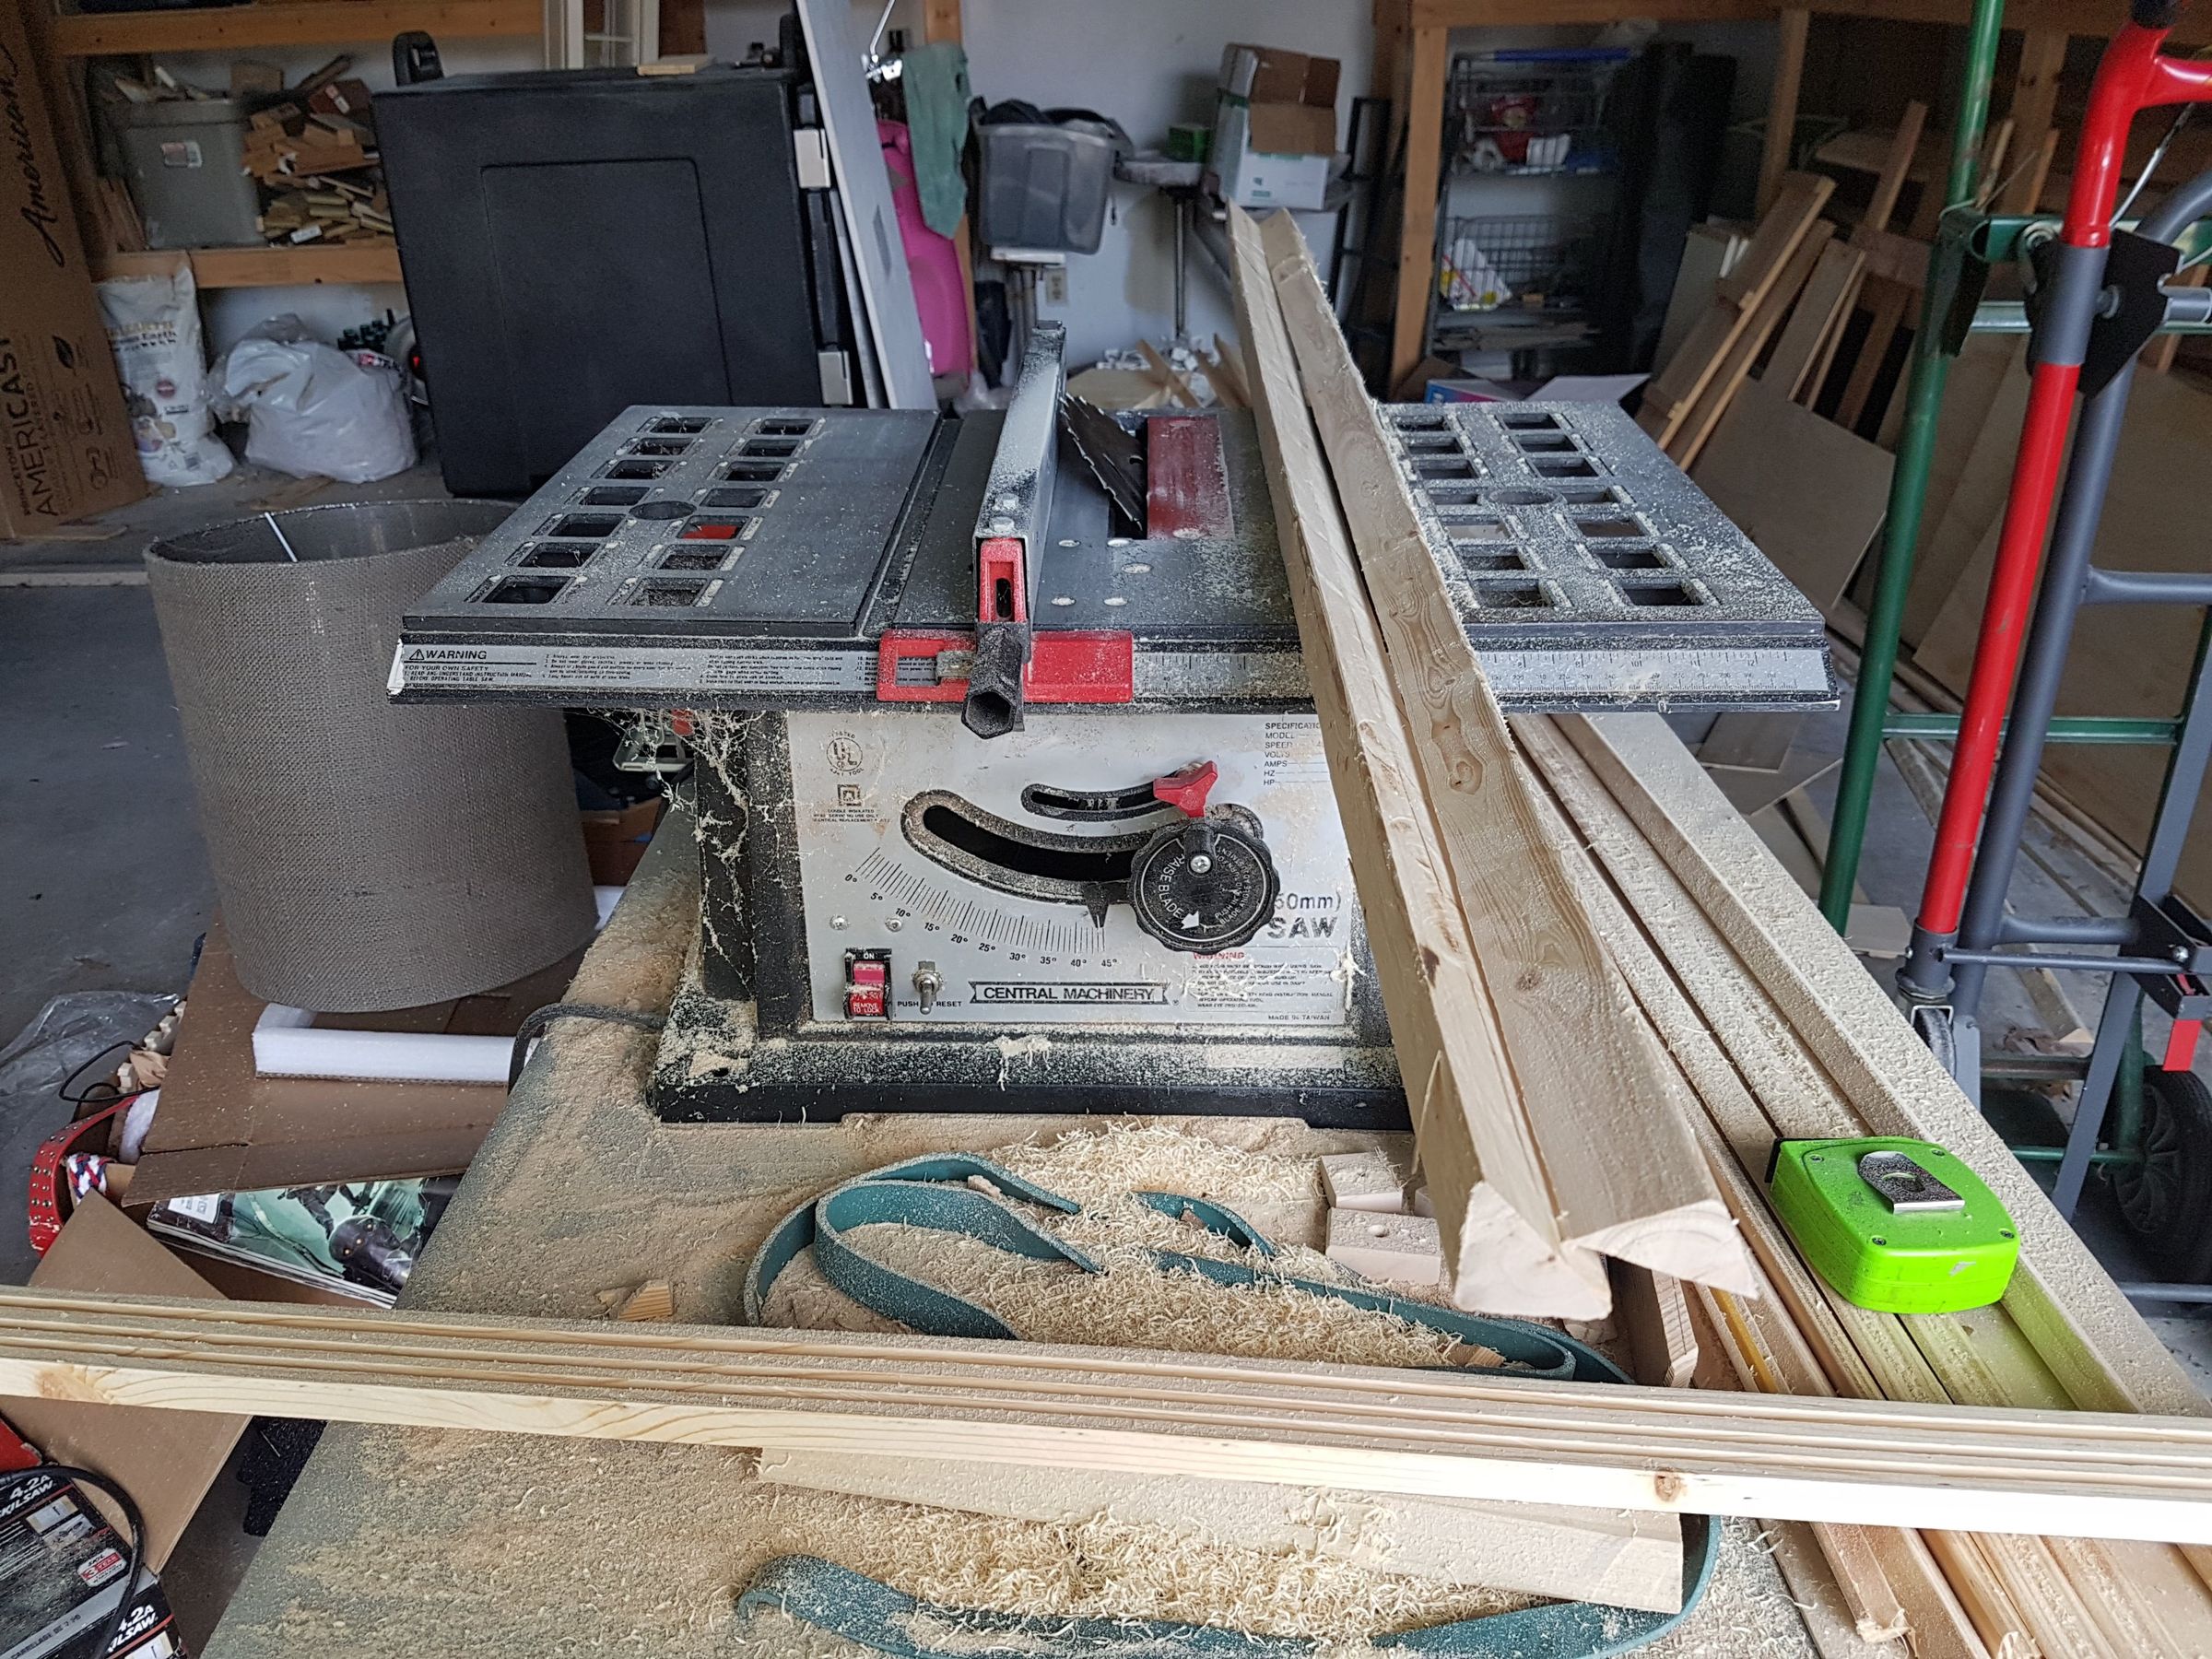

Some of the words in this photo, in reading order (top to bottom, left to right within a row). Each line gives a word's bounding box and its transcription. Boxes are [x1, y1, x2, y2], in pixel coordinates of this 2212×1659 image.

[6, 447, 31, 516] PRINCETON
[426, 650, 487, 660] WARNING
[1265, 741, 1293, 749] SPEED
[1159, 853, 1185, 882] RAISE
[1158, 885, 1184, 919] BLADE
[1214, 904, 1233, 920] PUSH
[1218, 906, 1242, 924] BLADE
[1267, 917, 1338, 939] SAW
[983, 987, 1058, 1000] CENTRAL
[1064, 988, 1154, 1001] MACHINERY
[10, 1475, 51, 1500] 4.2A
